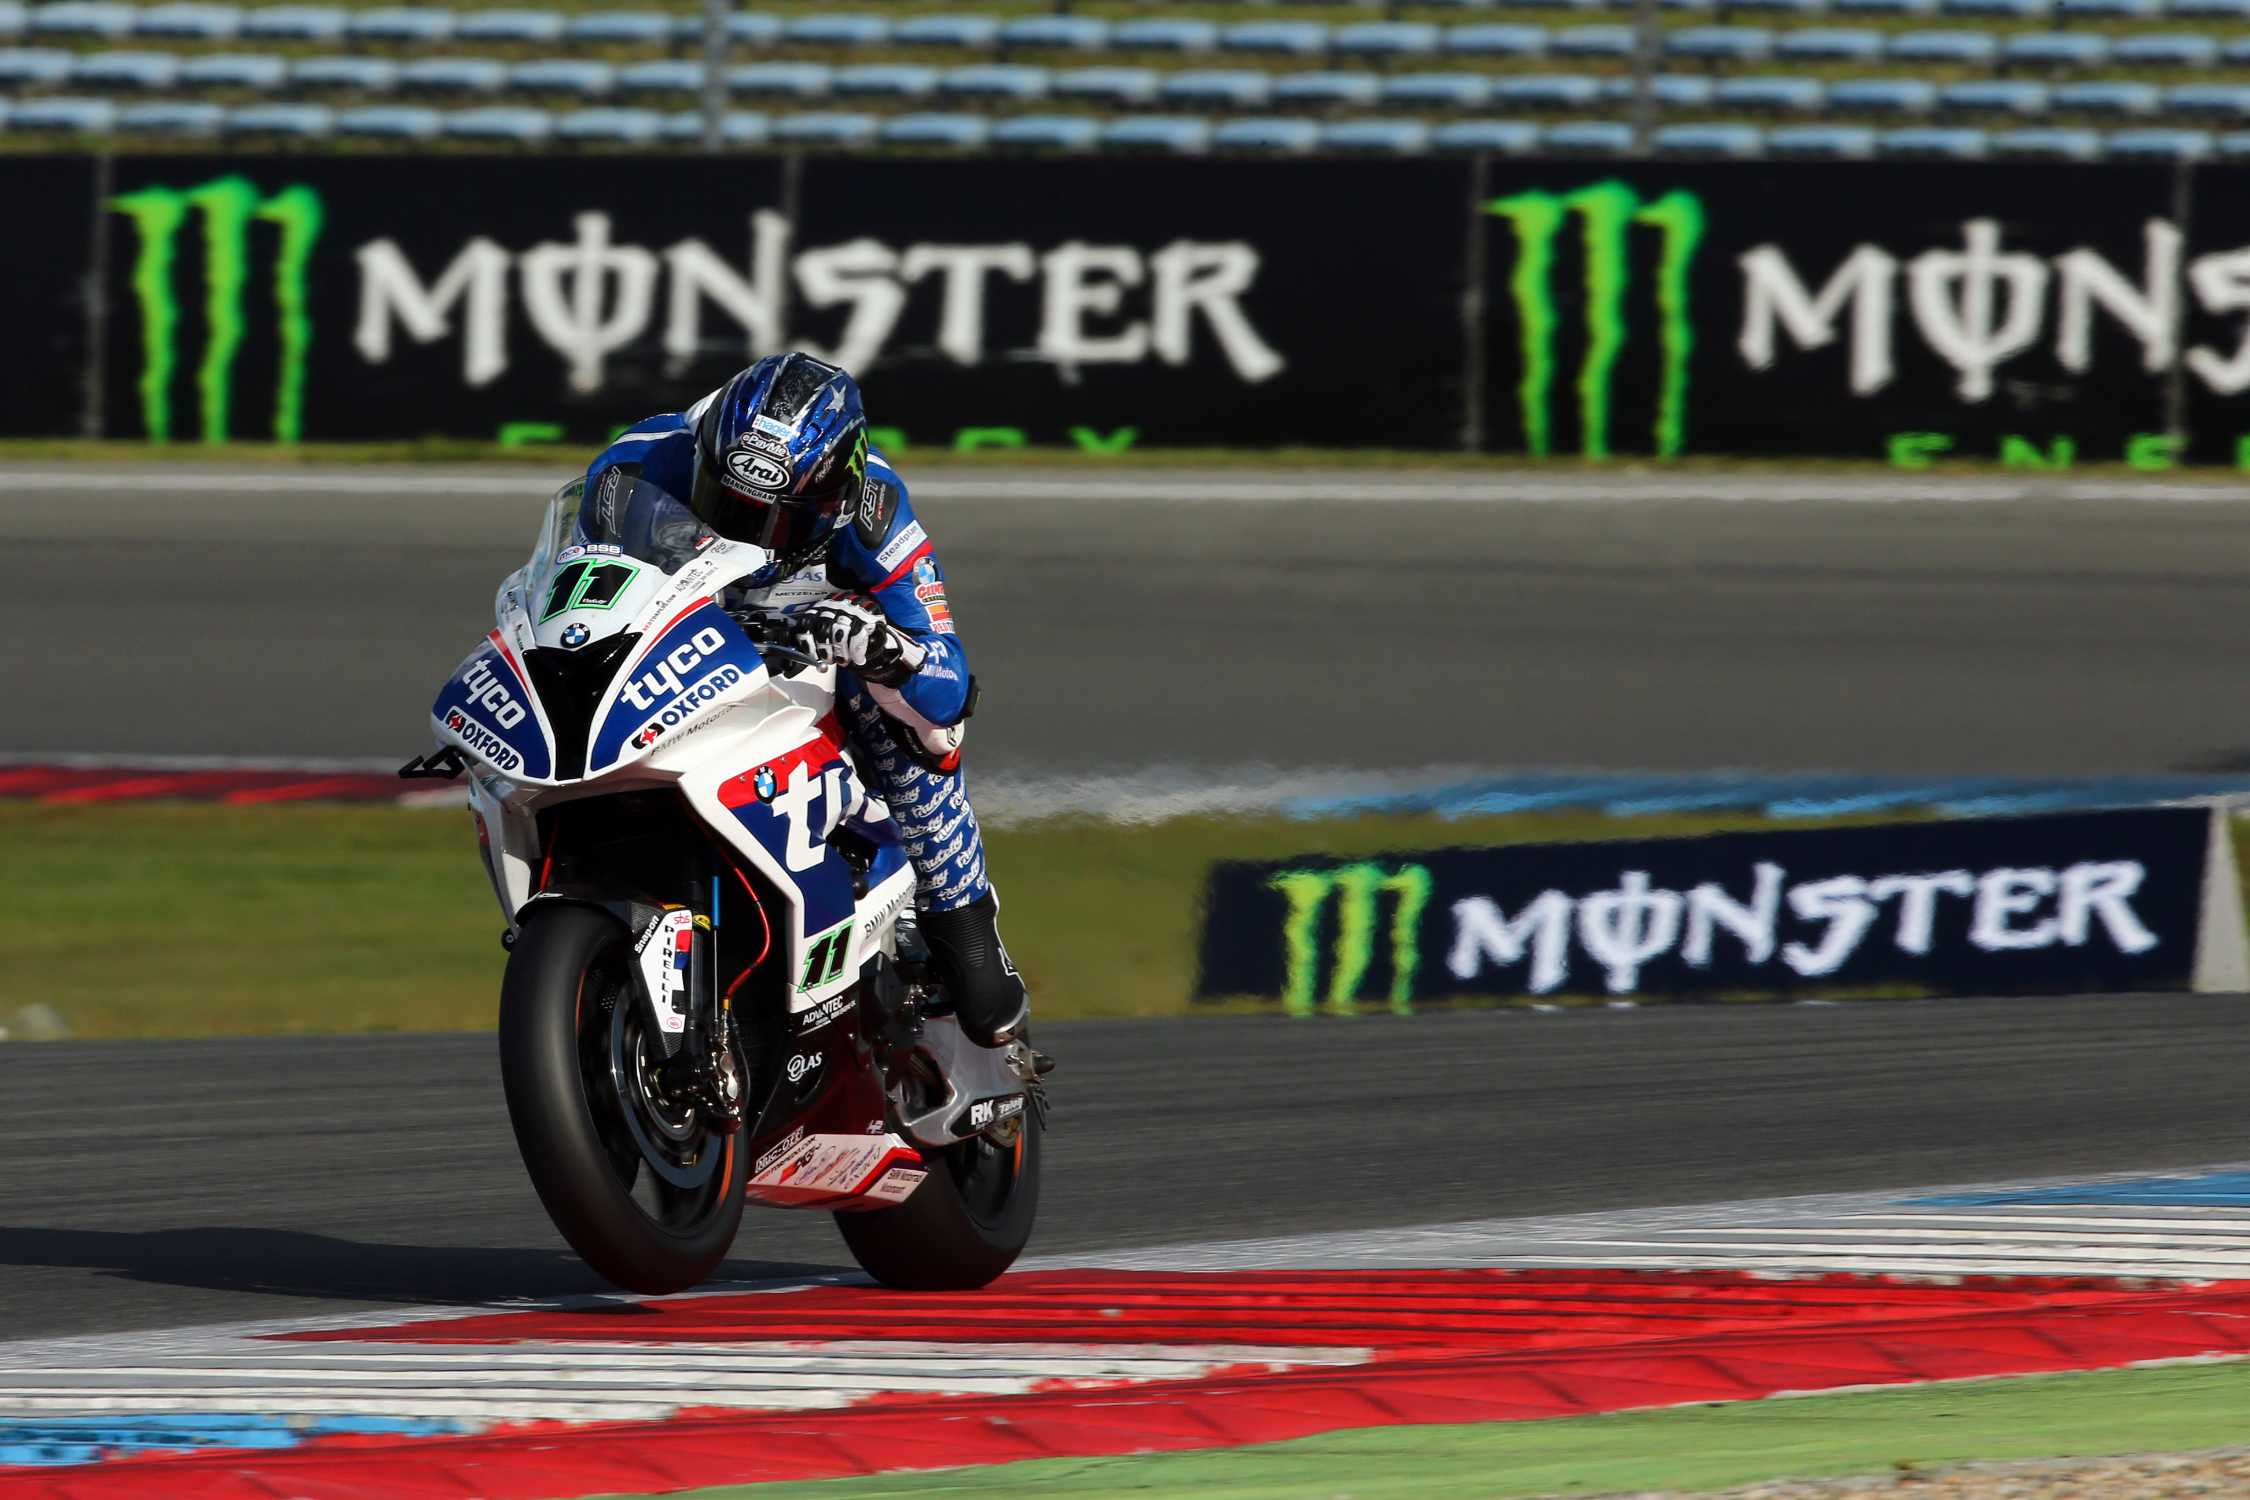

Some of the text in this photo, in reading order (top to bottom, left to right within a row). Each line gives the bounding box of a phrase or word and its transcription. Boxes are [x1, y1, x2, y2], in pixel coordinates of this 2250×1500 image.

[354, 210, 1284, 392] MONSTER
[722, 475, 776, 502] MANNINGHAM
[731, 457, 782, 482] Arai
[859, 476, 880, 531] RST
[586, 544, 621, 554] BSB
[540, 558, 641, 625] 11
[461, 658, 526, 731] tyco
[620, 626, 726, 712] tyco
[661, 667, 740, 727] OXFORD
[462, 723, 519, 772] OXFORD
[797, 918, 856, 993] 11
[1447, 860, 2158, 993] MONSTER
[661, 925, 675, 1004] PIRELLI
[802, 995, 844, 1026] ADVANTEC
[970, 1099, 994, 1126] RK
